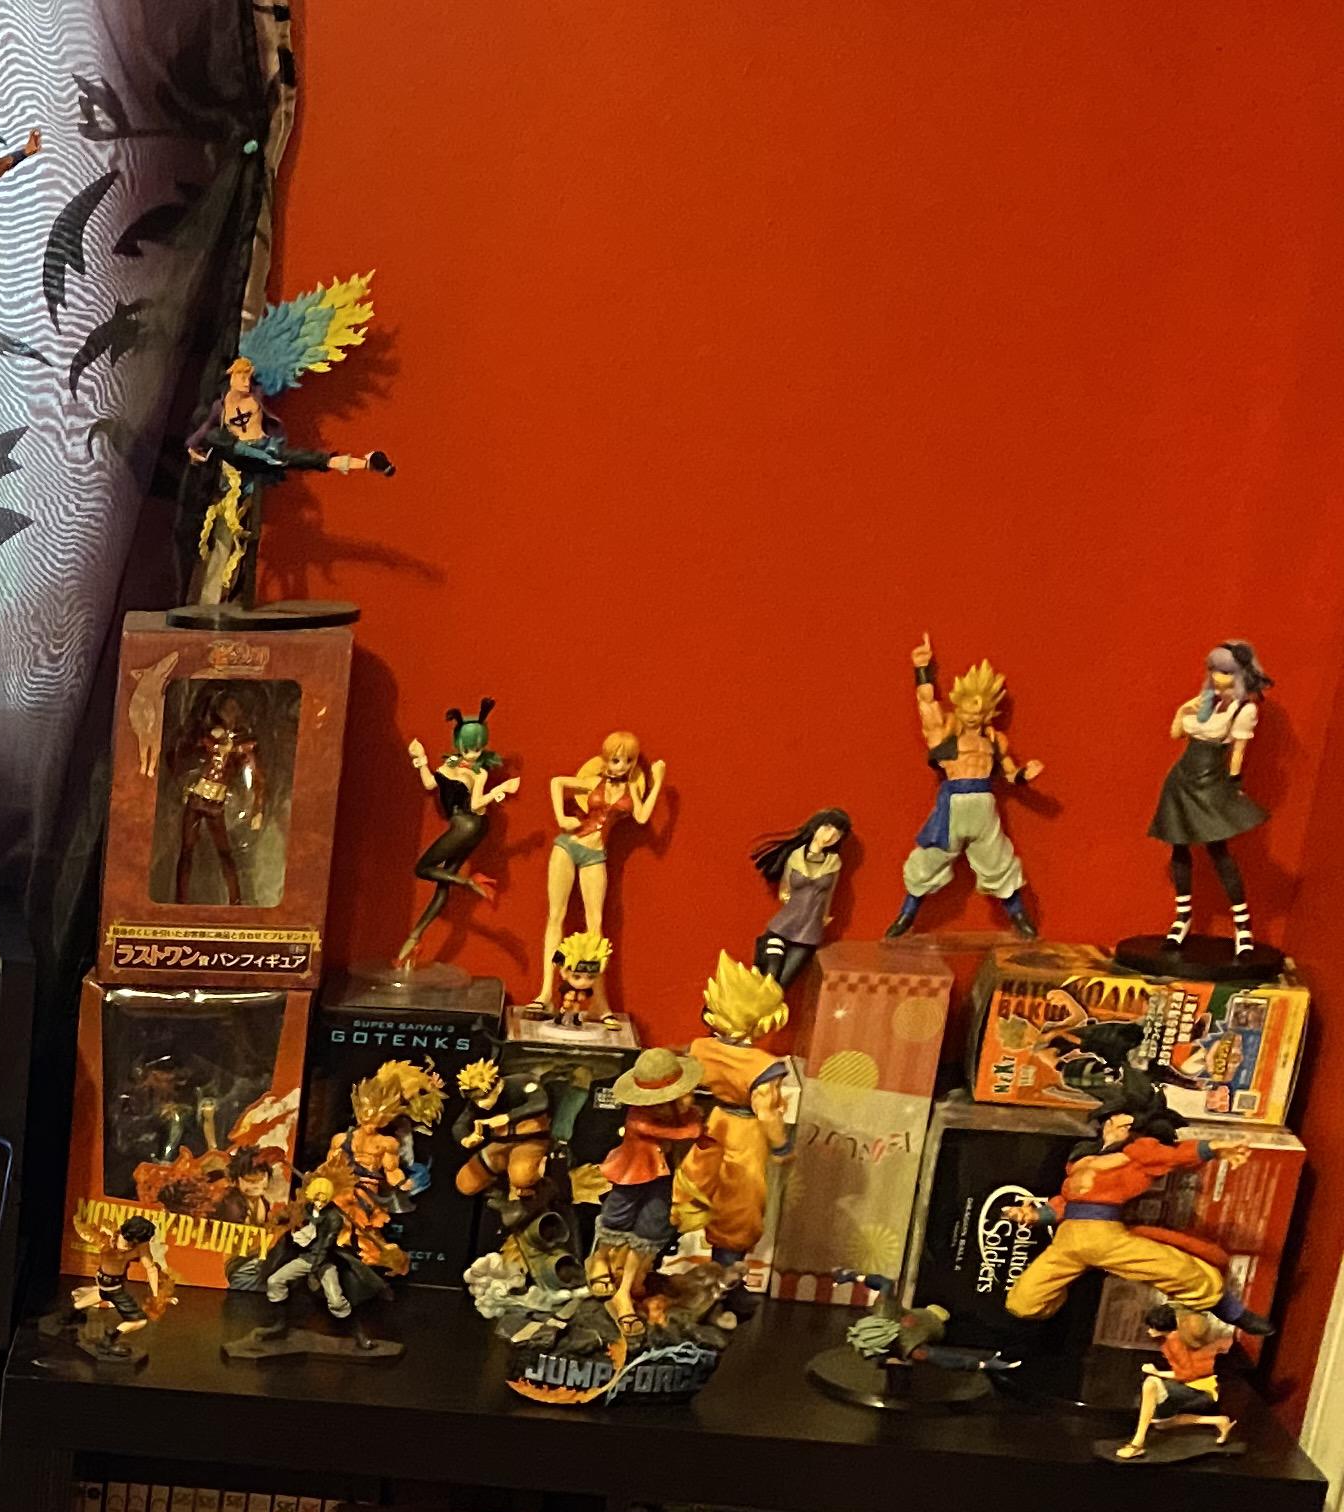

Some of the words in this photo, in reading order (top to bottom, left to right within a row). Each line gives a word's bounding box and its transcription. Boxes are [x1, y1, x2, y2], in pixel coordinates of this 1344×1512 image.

[330, 1030, 472, 1050] GOTENKS
[353, 1020, 394, 1029] SUPER
[398, 1022, 442, 1032] SAIYAN
[447, 1025, 455, 1033] 3
[976, 1218, 1012, 1293] Soldiers
[525, 1353, 612, 1388] JUMP
[616, 1361, 704, 1393] FORC
